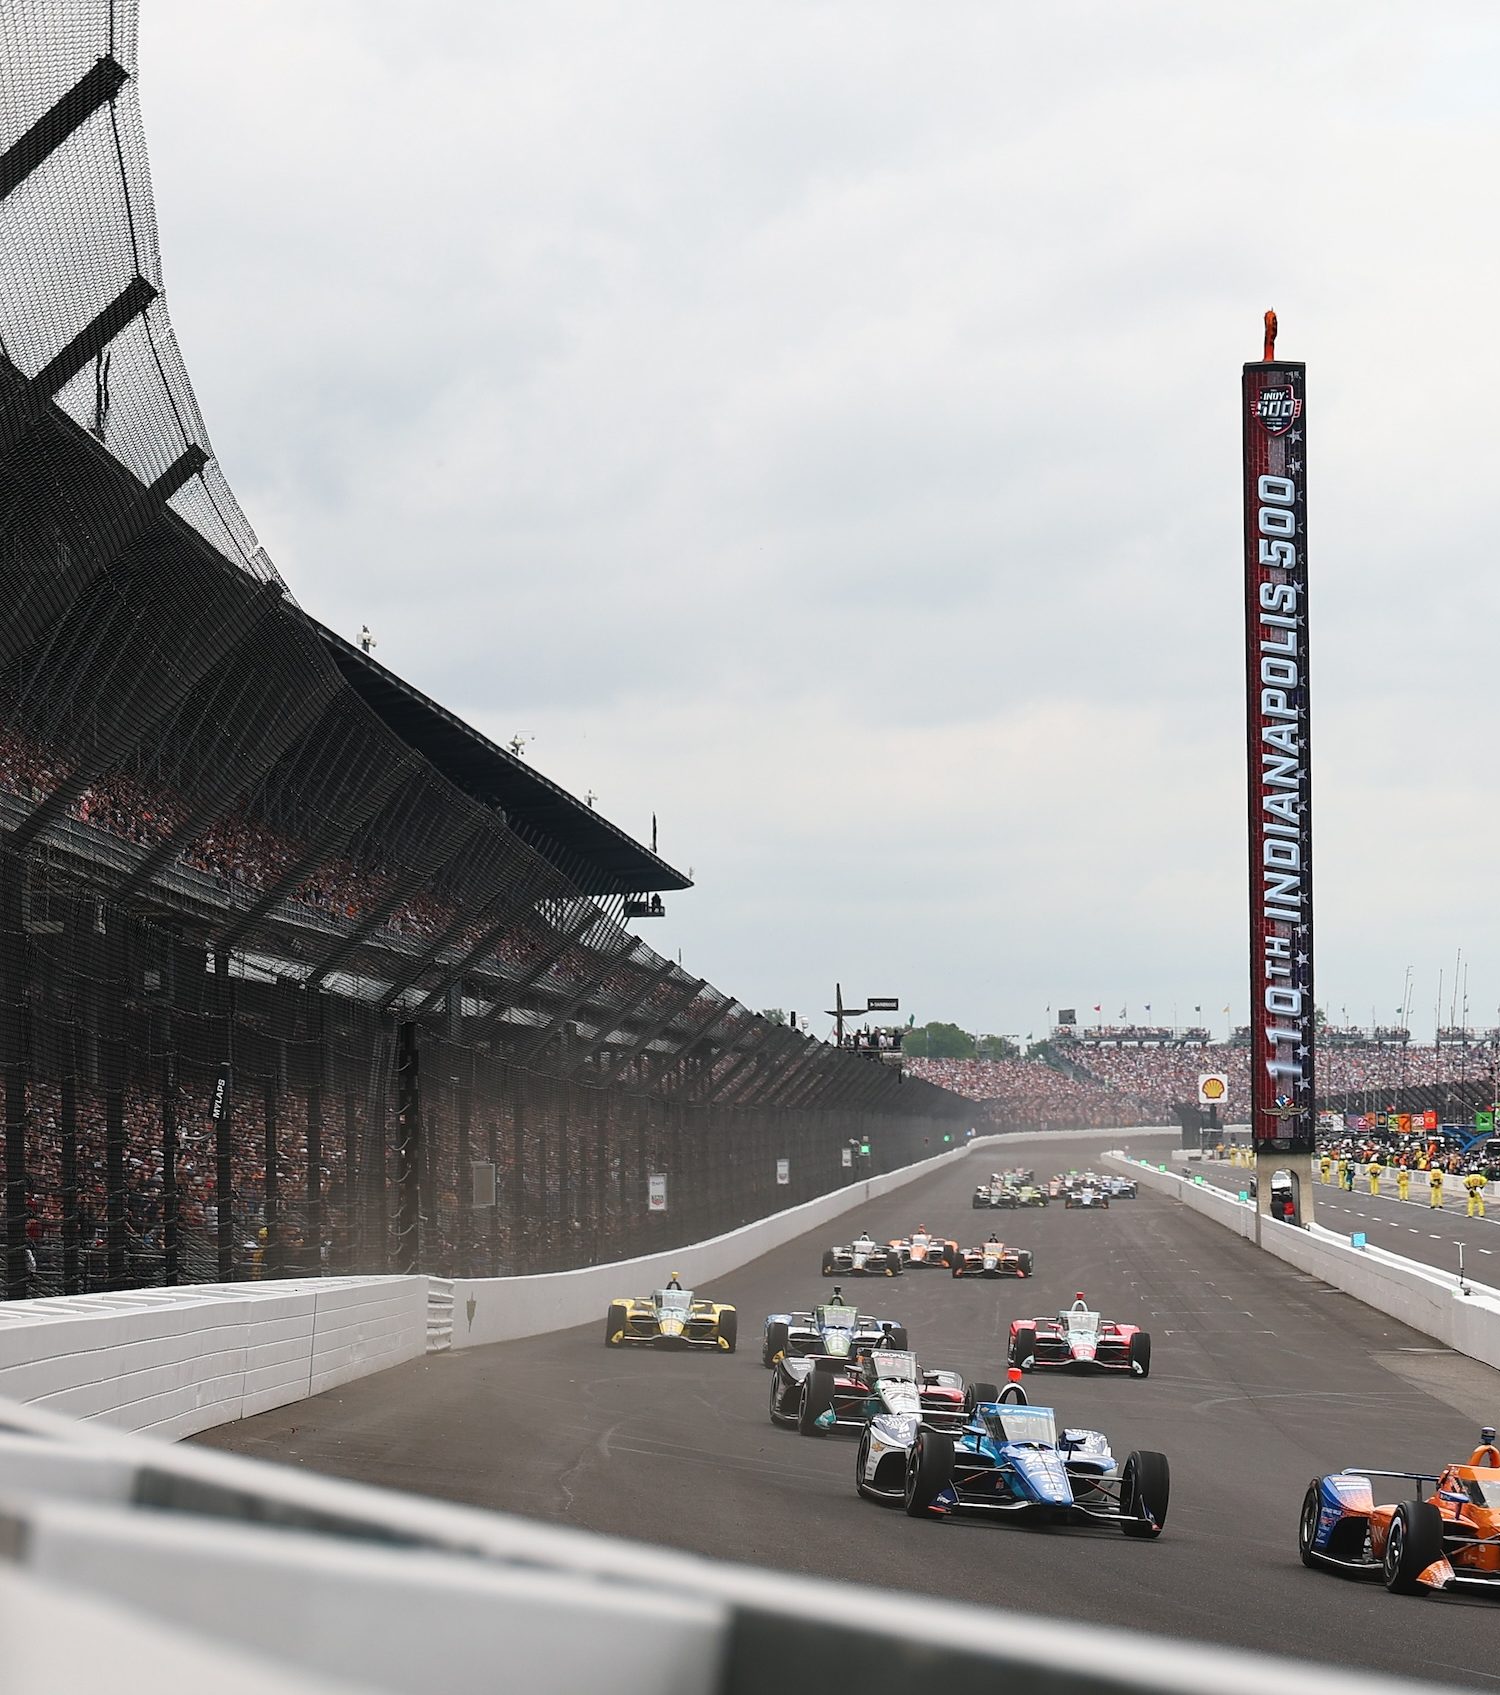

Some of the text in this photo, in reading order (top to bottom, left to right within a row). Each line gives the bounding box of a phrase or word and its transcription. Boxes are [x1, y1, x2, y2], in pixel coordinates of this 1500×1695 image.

[1258, 400, 1294, 416] 500
[1264, 392, 1286, 400] INDY
[1258, 475, 1302, 1081] 110TH INDIANAPOLIS 500
[212, 1078, 226, 1118] MYLAPS
